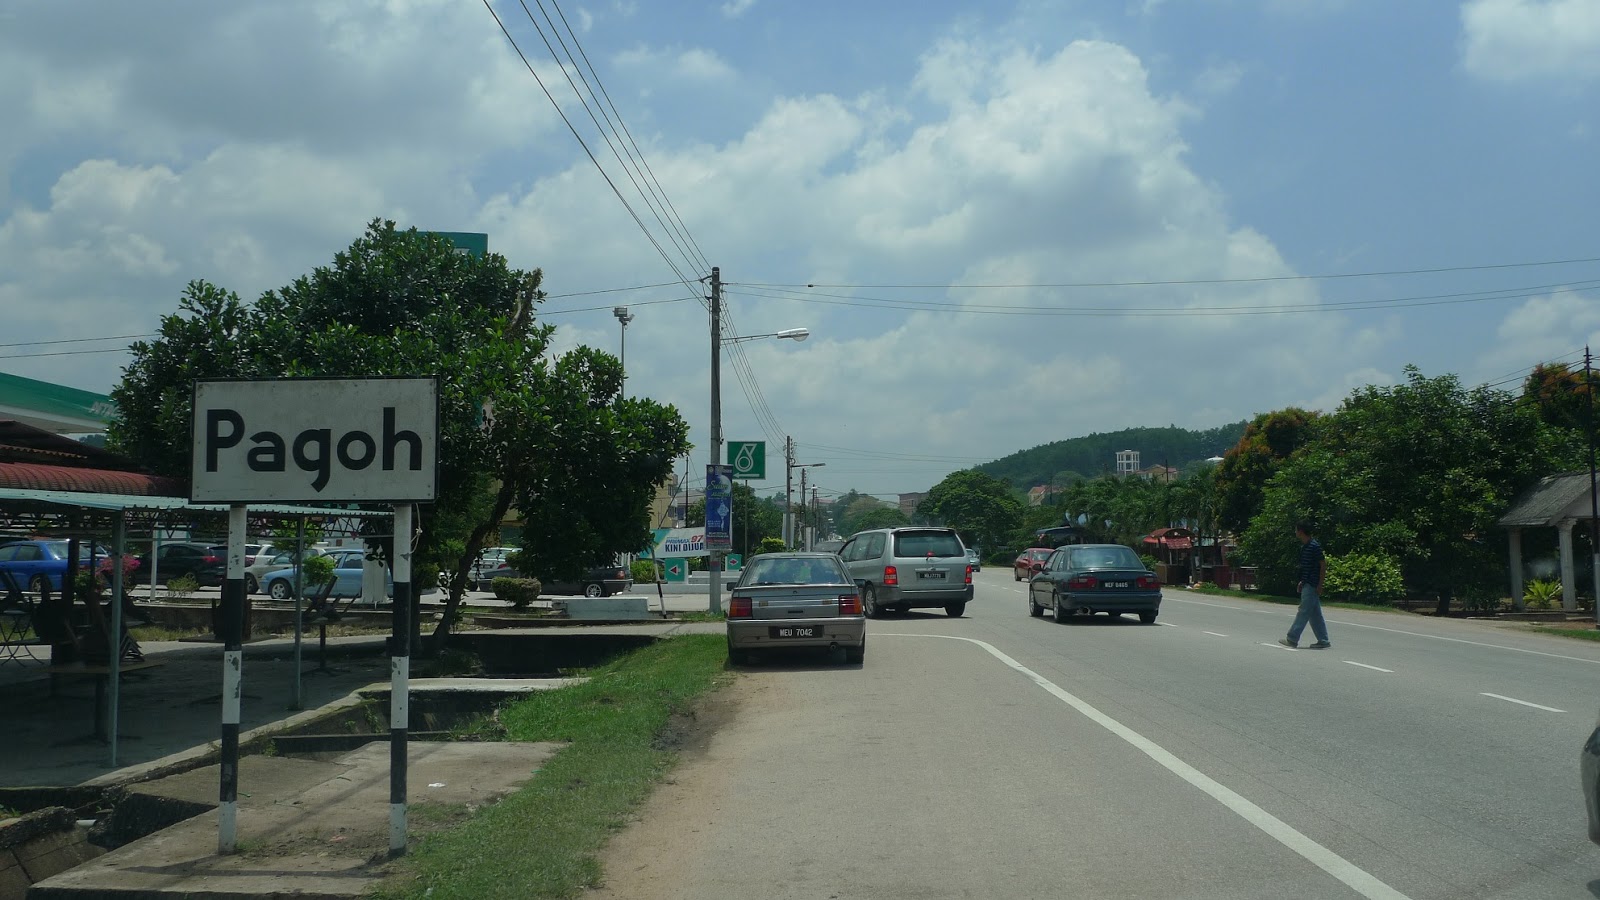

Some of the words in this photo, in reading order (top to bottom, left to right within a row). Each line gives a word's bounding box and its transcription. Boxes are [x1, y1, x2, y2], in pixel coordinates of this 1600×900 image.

[206, 407, 423, 492] Pagoh
[691, 535, 704, 543] 97
[665, 544, 681, 552] KINI
[683, 543, 704, 551] DIJUA
[795, 628, 813, 637] 7042
